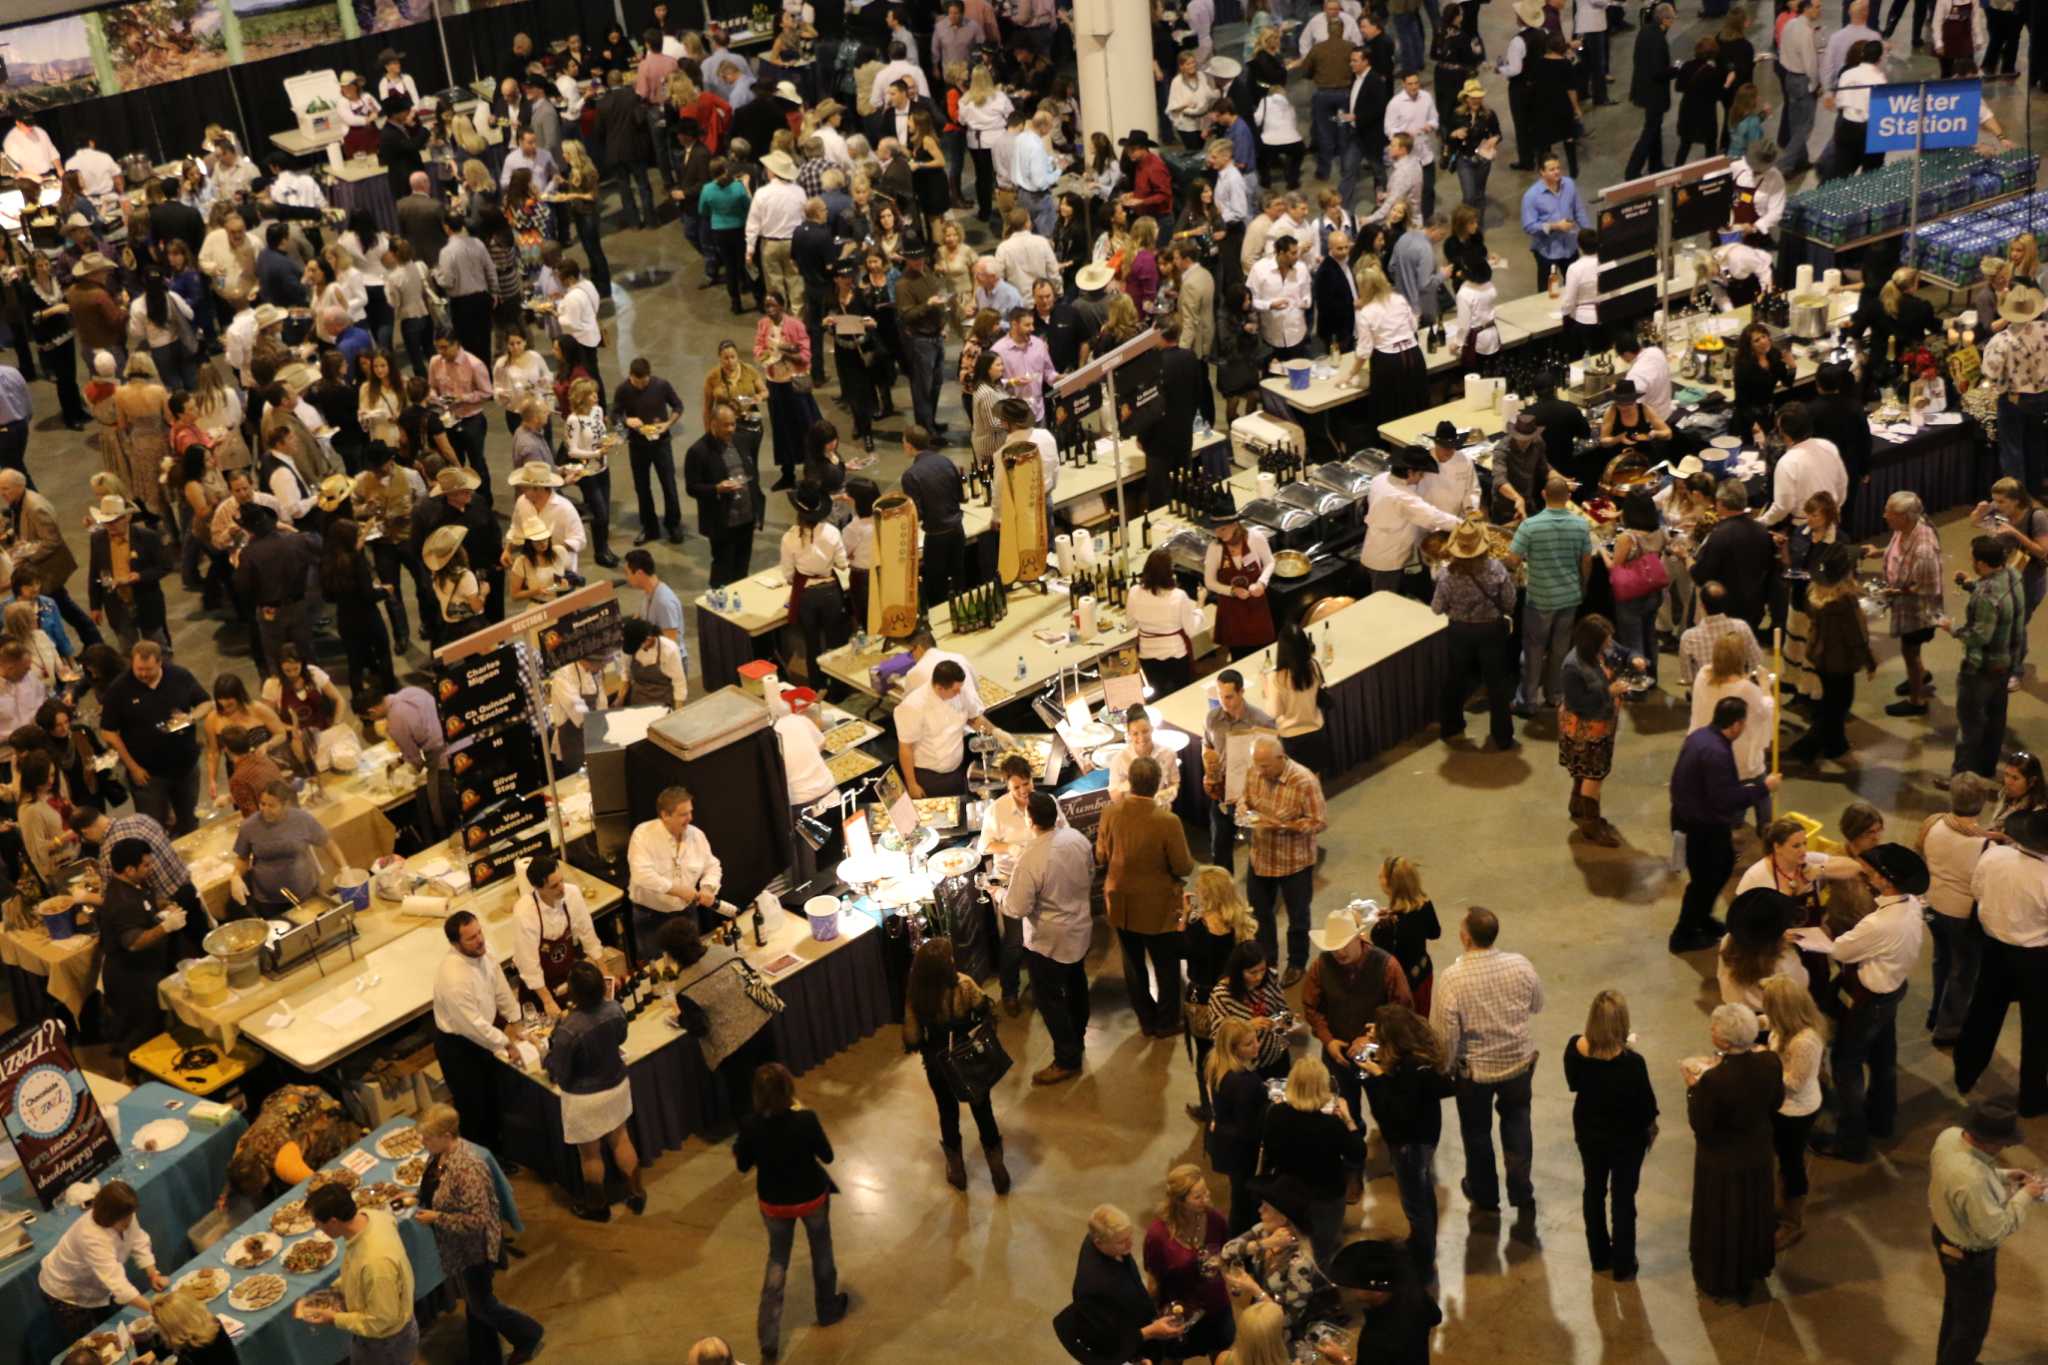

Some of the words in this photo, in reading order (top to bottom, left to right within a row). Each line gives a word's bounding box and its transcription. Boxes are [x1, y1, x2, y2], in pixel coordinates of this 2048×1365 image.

[1888, 94, 1960, 114] Water
[1878, 115, 1967, 137] Station
[511, 611, 543, 633] SECTION
[466, 660, 500, 679] Charles
[492, 772, 518, 788] Silver
[495, 782, 516, 795] Stag
[502, 811, 520, 823] Van
